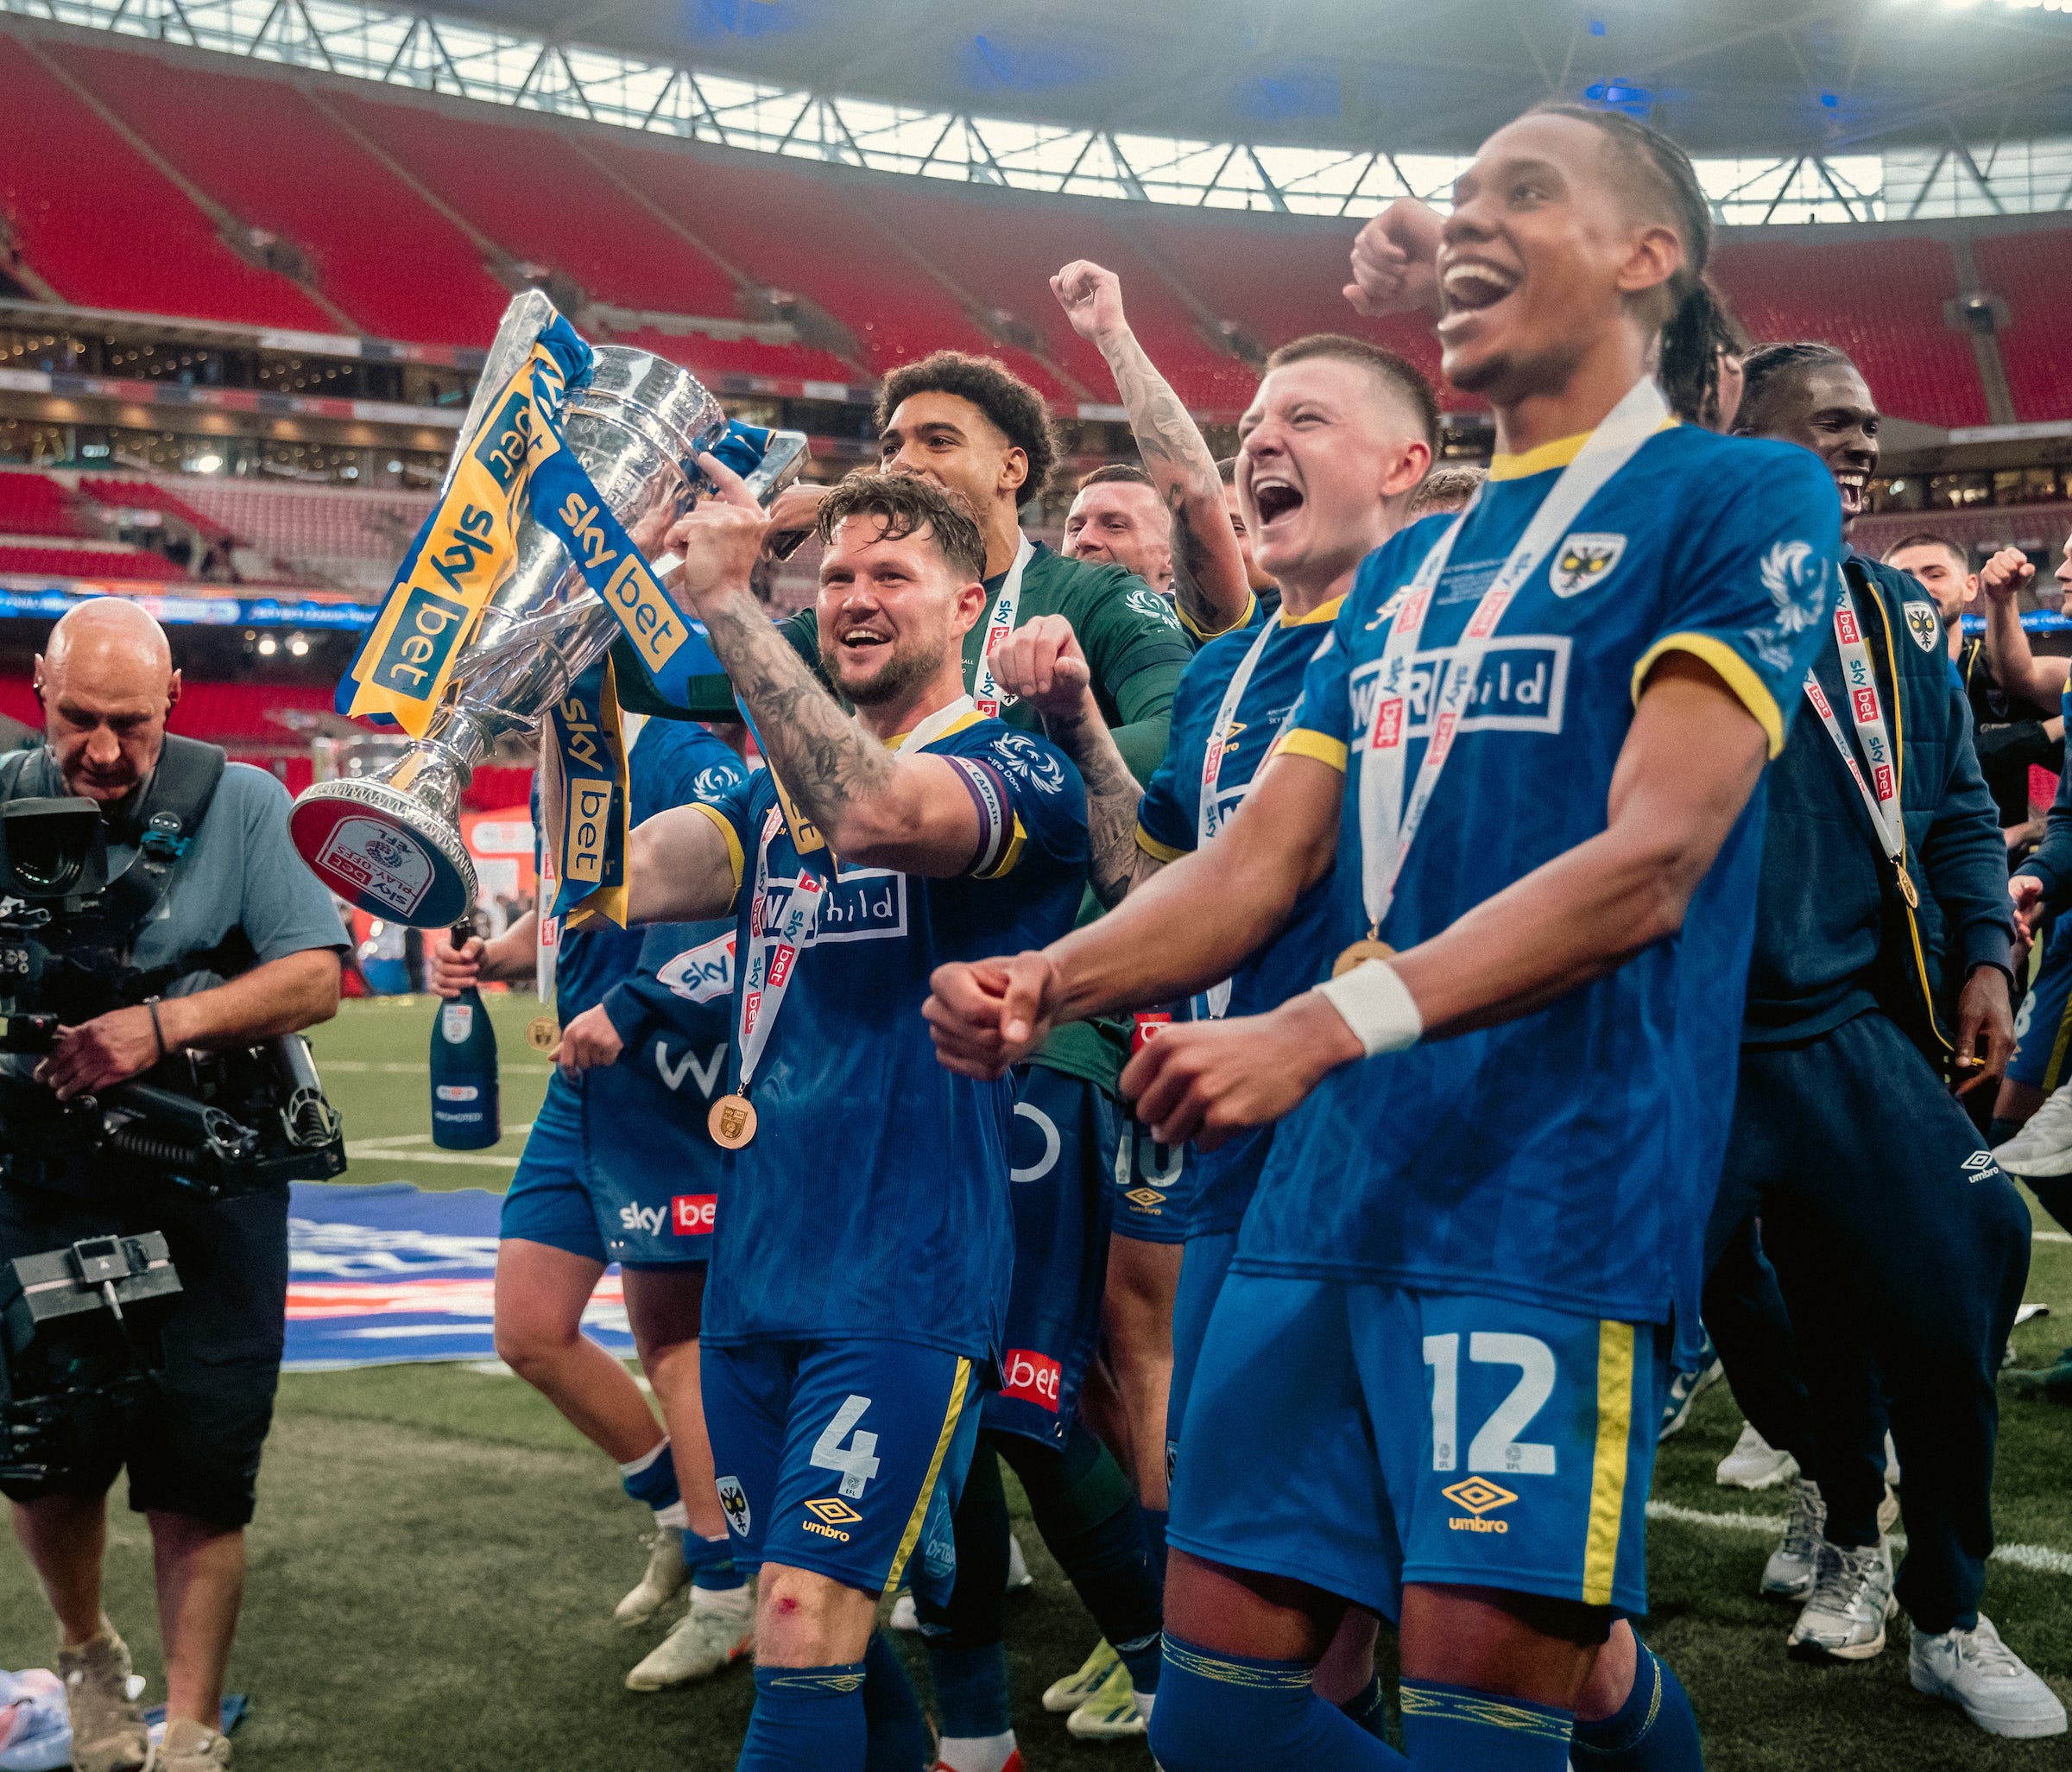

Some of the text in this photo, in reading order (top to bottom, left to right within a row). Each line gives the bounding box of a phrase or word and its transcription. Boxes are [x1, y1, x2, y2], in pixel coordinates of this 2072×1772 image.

[559, 492, 617, 569] sky
[616, 566, 673, 655] bet
[390, 504, 495, 687] sky bet
[994, 600, 1013, 624] sky
[1839, 612, 1856, 642] bet
[1811, 687, 1830, 715] bet
[1850, 659, 1875, 721] sky bet
[1835, 732, 1849, 757] sky
[560, 696, 608, 870] sky bet
[1868, 736, 1890, 800] sky bet
[972, 771, 999, 826] CAPTAIN
[380, 830, 408, 852] EFL
[332, 856, 408, 905] sky bet
[337, 845, 414, 895] PLAY-OFFS
[771, 908, 805, 983] sky bet
[681, 955, 729, 991] sky
[749, 956, 762, 989] sky
[1968, 1166, 1999, 1183] umbro
[619, 1199, 667, 1237] sky
[1008, 1352, 1059, 1401] bet
[1423, 1332, 1556, 1475] 12
[809, 1394, 881, 1499] 4
[846, 1488, 855, 1497] EFL
[802, 1520, 850, 1543] umbro
[1449, 1515, 1508, 1534] umbro
